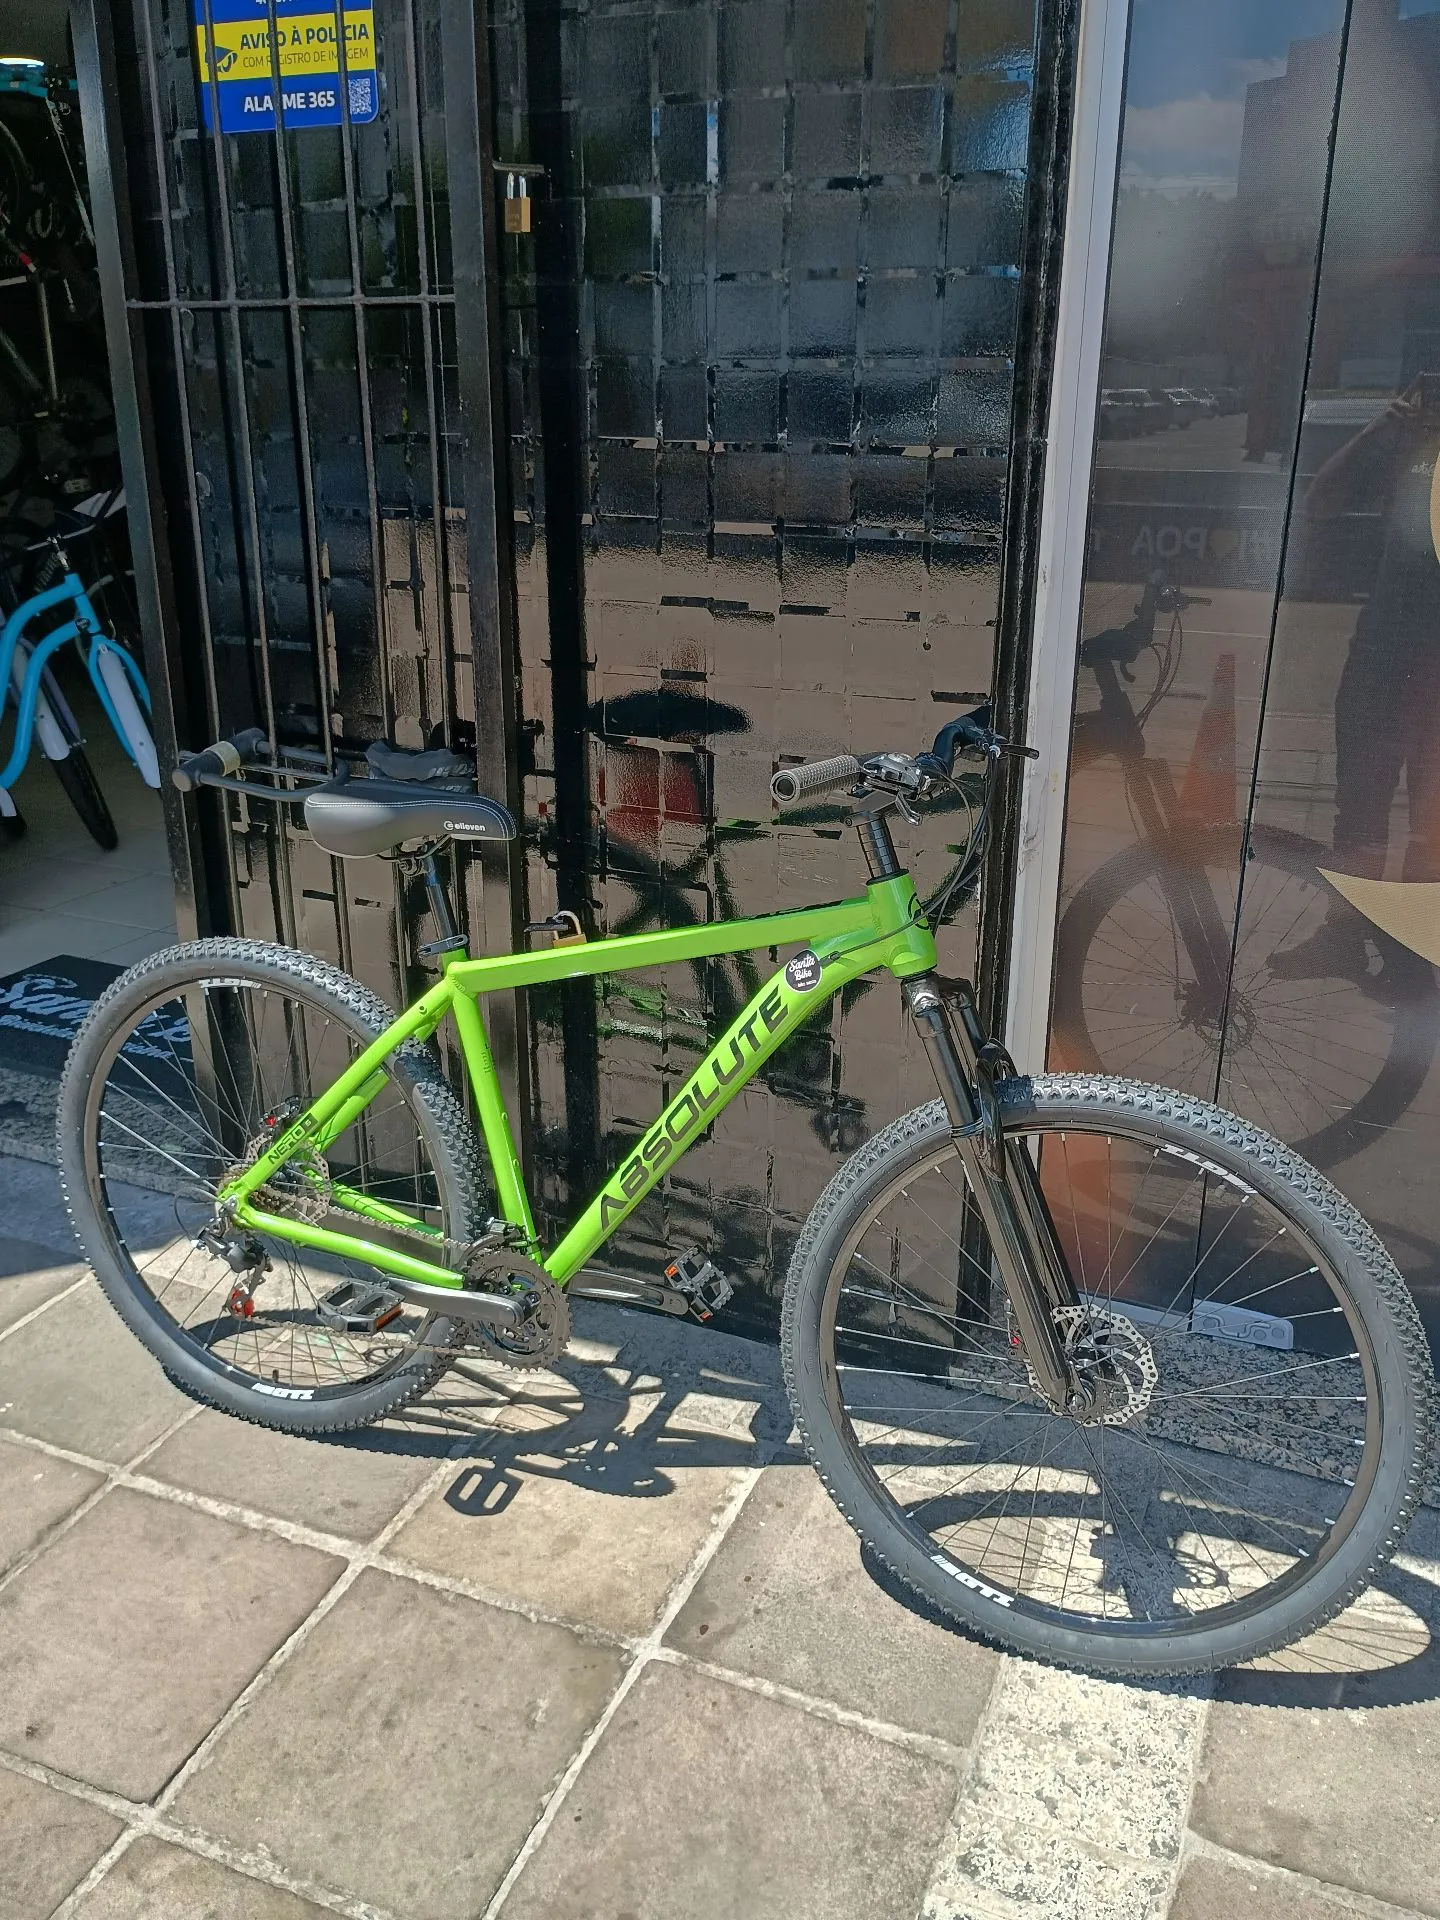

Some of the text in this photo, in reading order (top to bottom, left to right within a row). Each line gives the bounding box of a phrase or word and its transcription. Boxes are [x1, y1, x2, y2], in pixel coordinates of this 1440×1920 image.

[290, 26, 303, 46] À
[306, 23, 370, 45] POLCIA
[242, 47, 369, 68] COM RGISTRO DE IMGEM
[243, 91, 336, 113] ALAME 365
[789, 953, 816, 972] Santa
[794, 968, 813, 981] Bike
[600, 984, 789, 1231] ABSOLUTE
[267, 1124, 306, 1164] NERO
